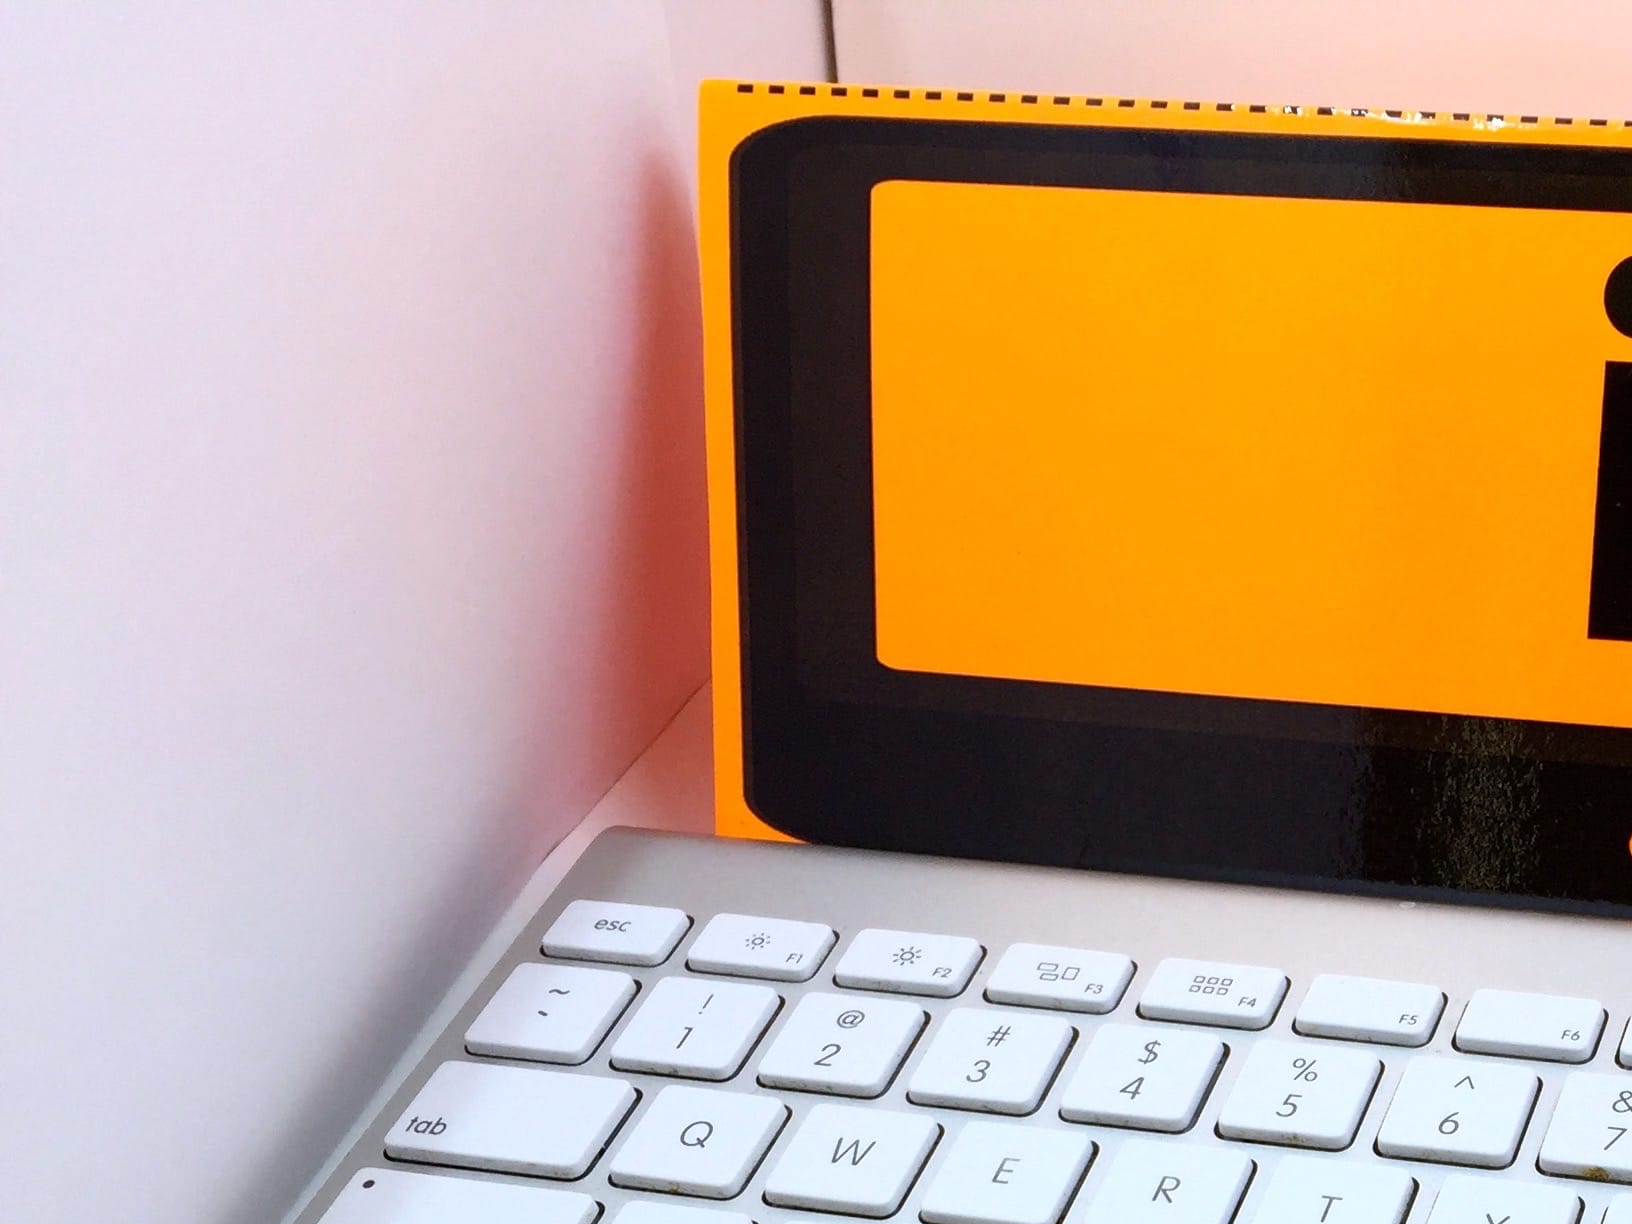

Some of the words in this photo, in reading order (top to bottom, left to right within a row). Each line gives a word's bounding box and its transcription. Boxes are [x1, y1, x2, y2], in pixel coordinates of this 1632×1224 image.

[593, 918, 632, 933] esc
[785, 952, 804, 964] F1
[932, 966, 953, 978] F2
[1084, 983, 1104, 995] F3
[1237, 996, 1257, 1008] F4
[836, 1009, 866, 1029] @
[1398, 1013, 1418, 1026] F5
[676, 1026, 694, 1050] 1
[986, 1025, 1012, 1047] #
[1560, 1029, 1581, 1041] F6
[813, 1043, 842, 1067] 2
[1137, 1039, 1162, 1065] $
[965, 1059, 991, 1083] 3
[1292, 1057, 1318, 1082] %
[1119, 1076, 1145, 1100] 4
[1275, 1093, 1303, 1118] 5
[405, 1116, 447, 1136] tab
[679, 1120, 714, 1149] Q
[1438, 1111, 1460, 1135] 6
[1603, 1126, 1628, 1151] 7
[831, 1137, 877, 1166] W
[991, 1157, 1020, 1185] E
[1151, 1175, 1181, 1204] R
[1320, 1195, 1343, 1223] T
